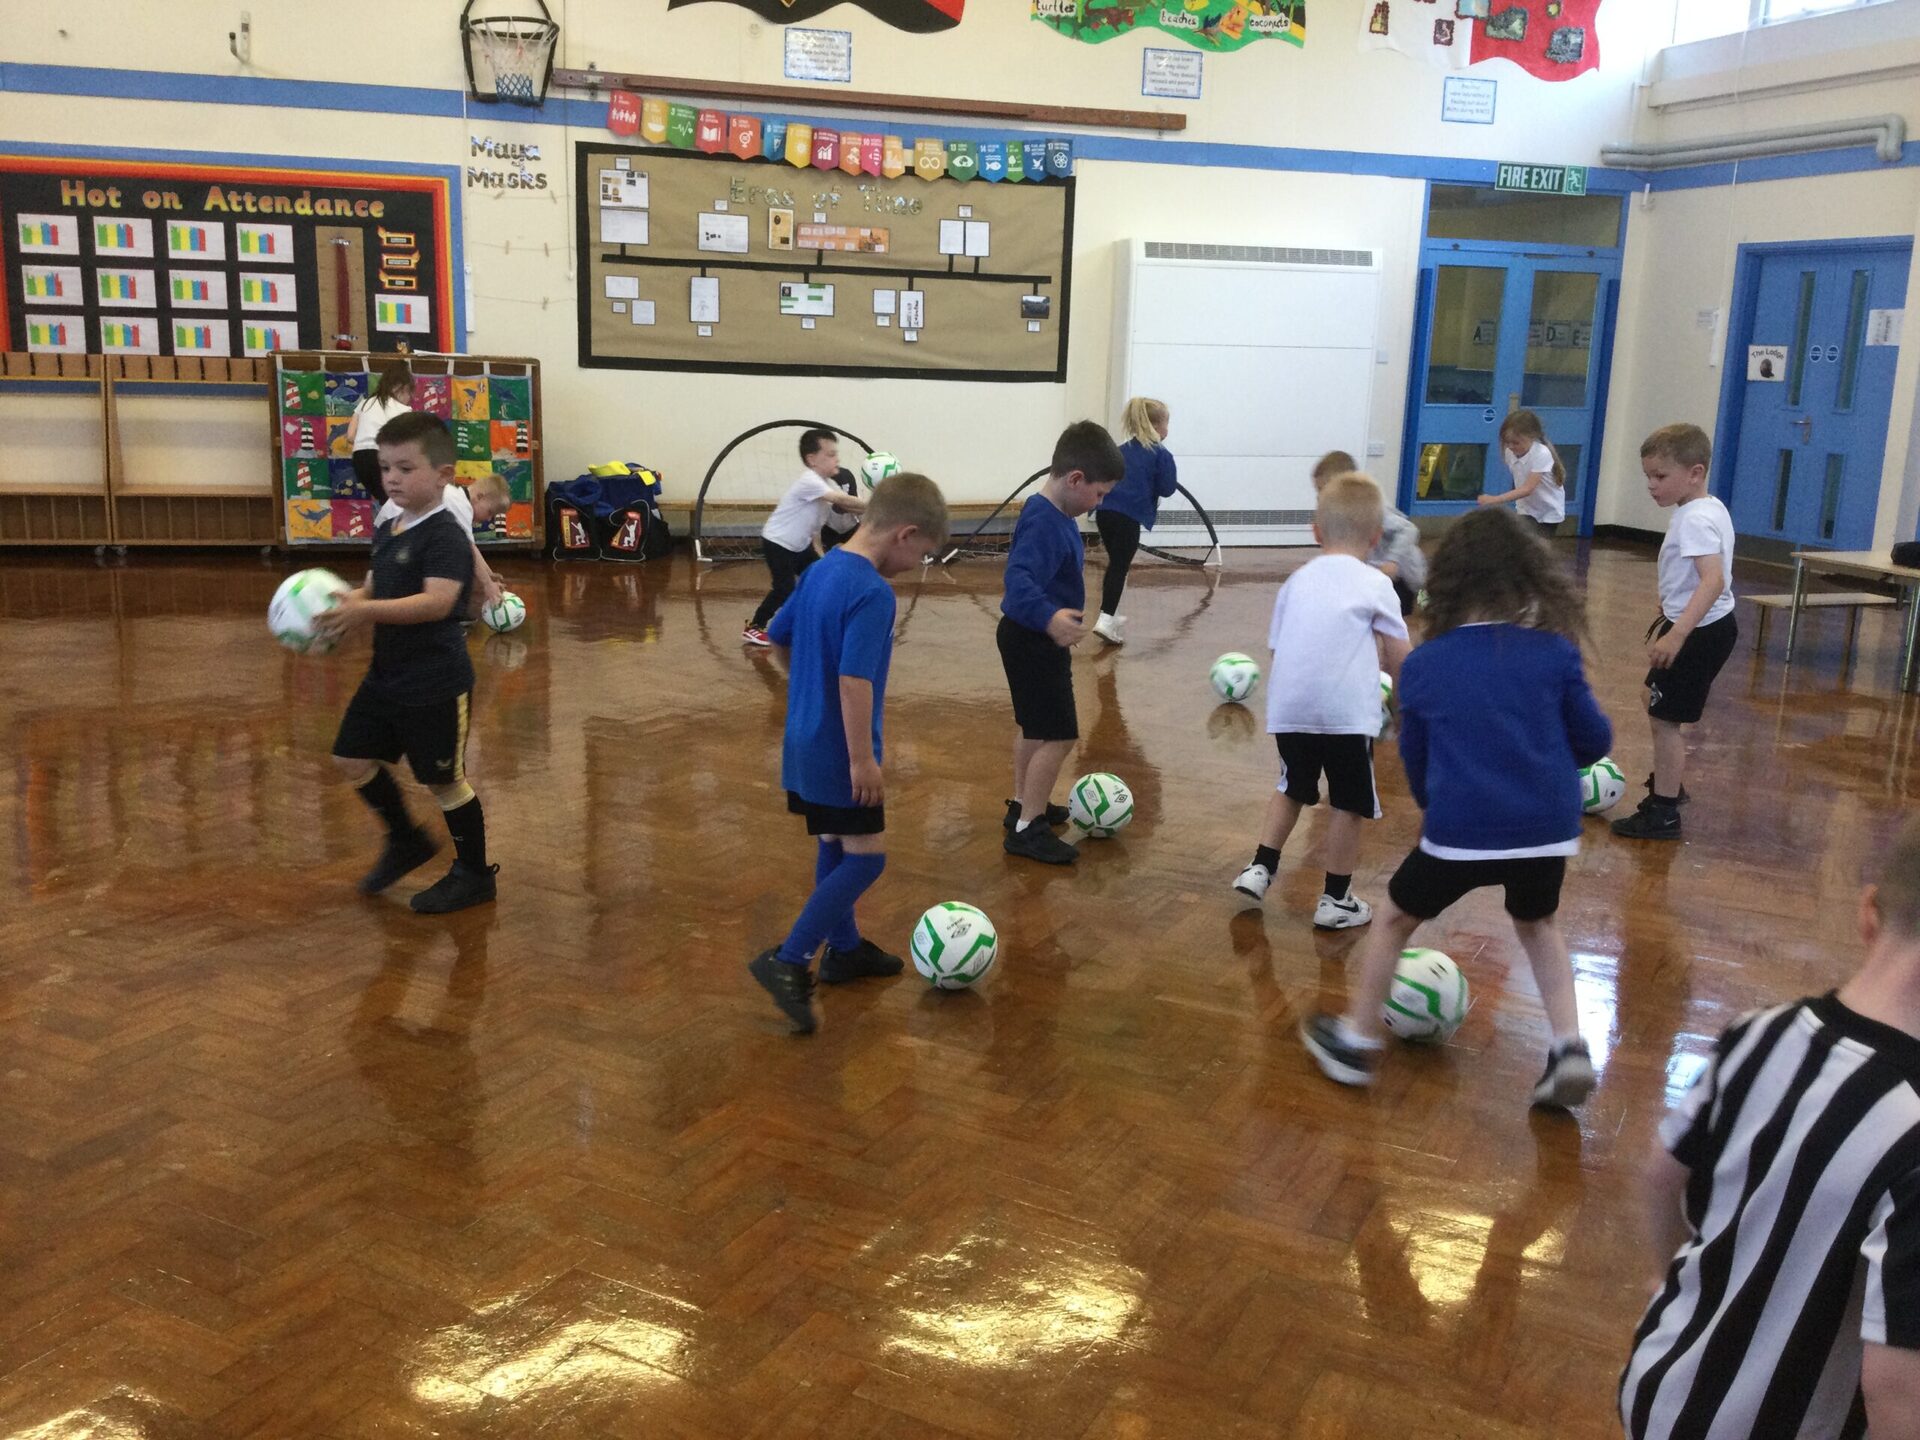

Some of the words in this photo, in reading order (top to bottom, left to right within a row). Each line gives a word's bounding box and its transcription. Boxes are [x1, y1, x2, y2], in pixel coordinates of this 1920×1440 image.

[1161, 10, 1197, 26] beaches
[471, 136, 541, 169] Maya
[467, 166, 548, 189] Masks
[1499, 165, 1530, 188] FIRE
[1531, 168, 1563, 190] EXIT
[60, 180, 121, 208] Hot
[142, 189, 183, 210] on
[203, 185, 385, 218] Attendance
[730, 175, 795, 207] Eras
[812, 184, 843, 209] of
[857, 183, 923, 215] Time
[1751, 350, 1765, 359] The
[1765, 348, 1785, 360] Lodge
